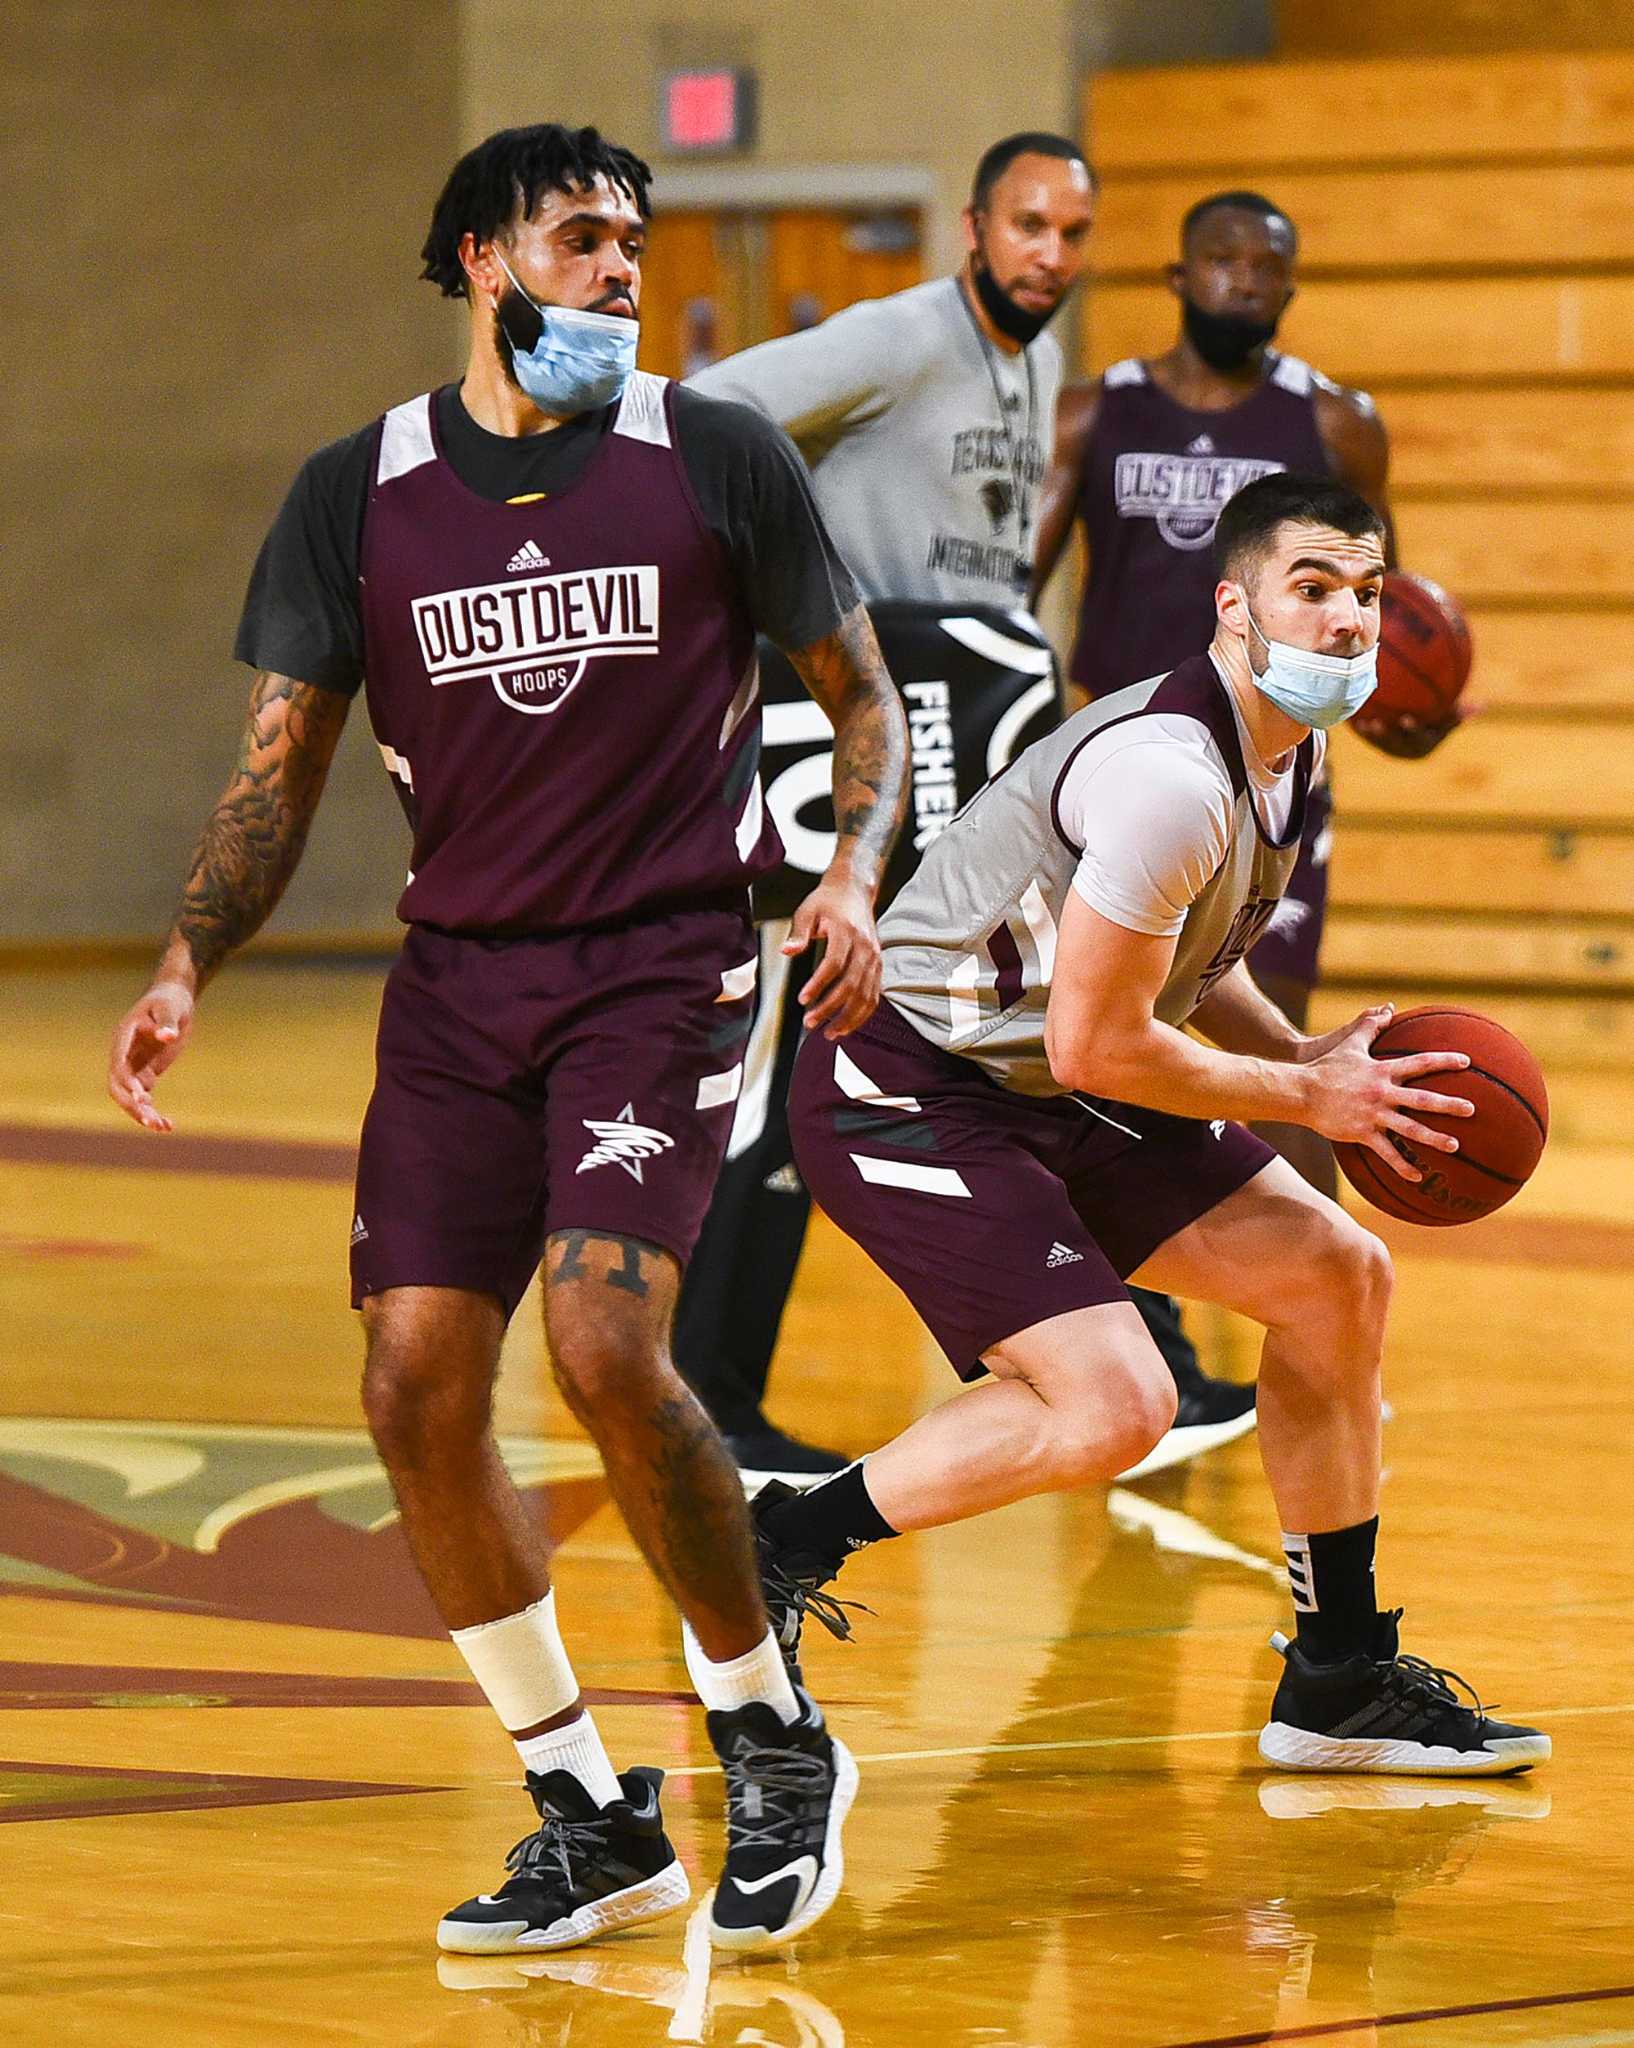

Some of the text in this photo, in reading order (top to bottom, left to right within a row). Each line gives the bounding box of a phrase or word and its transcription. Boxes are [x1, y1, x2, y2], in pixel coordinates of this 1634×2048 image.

[505, 556, 551, 573] adidas
[418, 573, 653, 665] DUSTDEVIL
[511, 667, 568, 696] HOOPS
[1046, 1252, 1085, 1269] adidas
